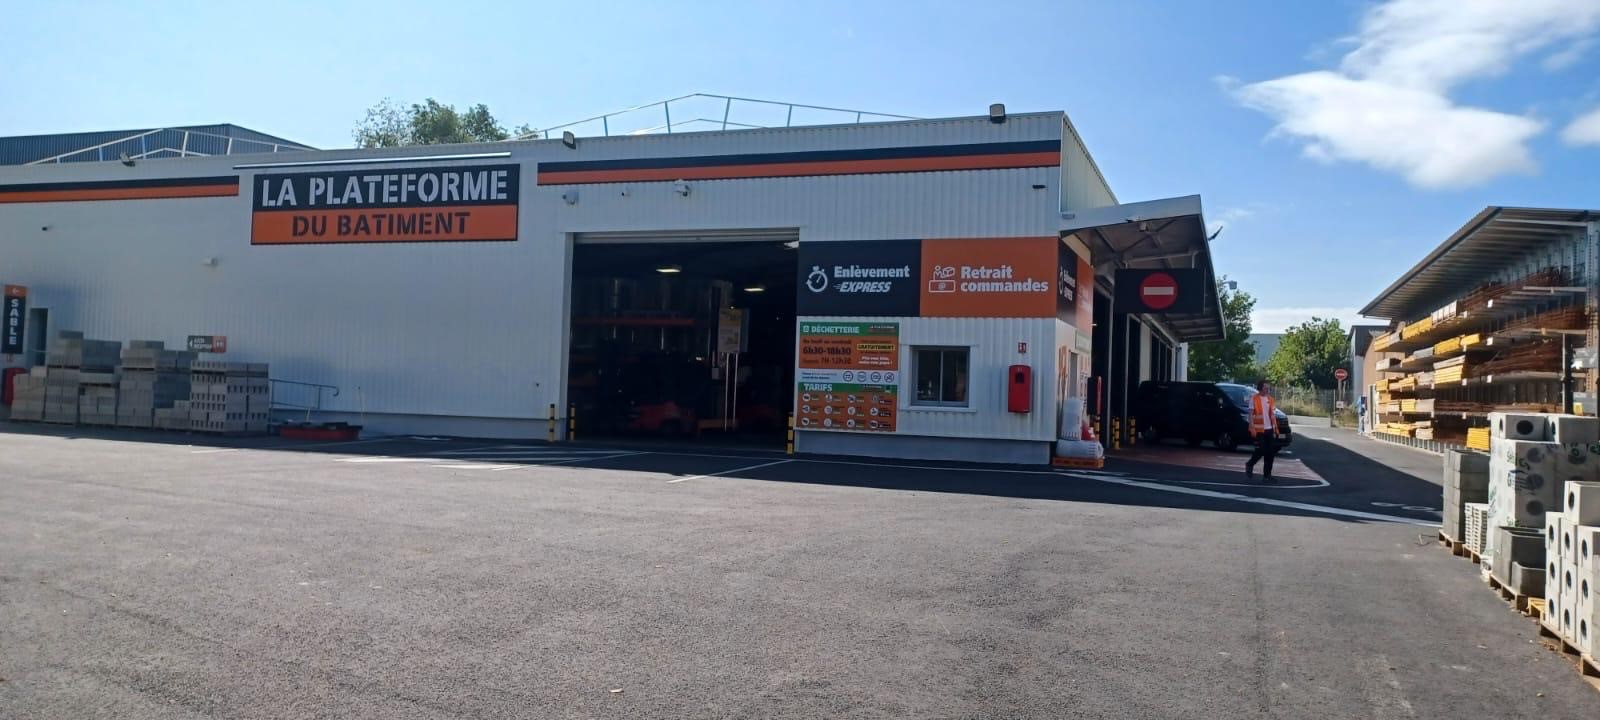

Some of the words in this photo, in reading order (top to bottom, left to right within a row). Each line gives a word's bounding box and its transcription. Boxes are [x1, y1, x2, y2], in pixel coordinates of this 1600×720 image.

[262, 178, 297, 206] LA
[309, 171, 507, 206] PLATEFORME
[292, 215, 327, 237] DU
[337, 212, 470, 236] BATIMENT
[834, 265, 910, 278] Enlèvement
[960, 265, 1012, 279] Retrait
[840, 281, 892, 293] EXPRESS
[960, 278, 1049, 292] commandes
[9, 298, 19, 345] SABLE
[811, 325, 860, 334] DÉCHETTERIE
[804, 383, 832, 391] TARIFS
